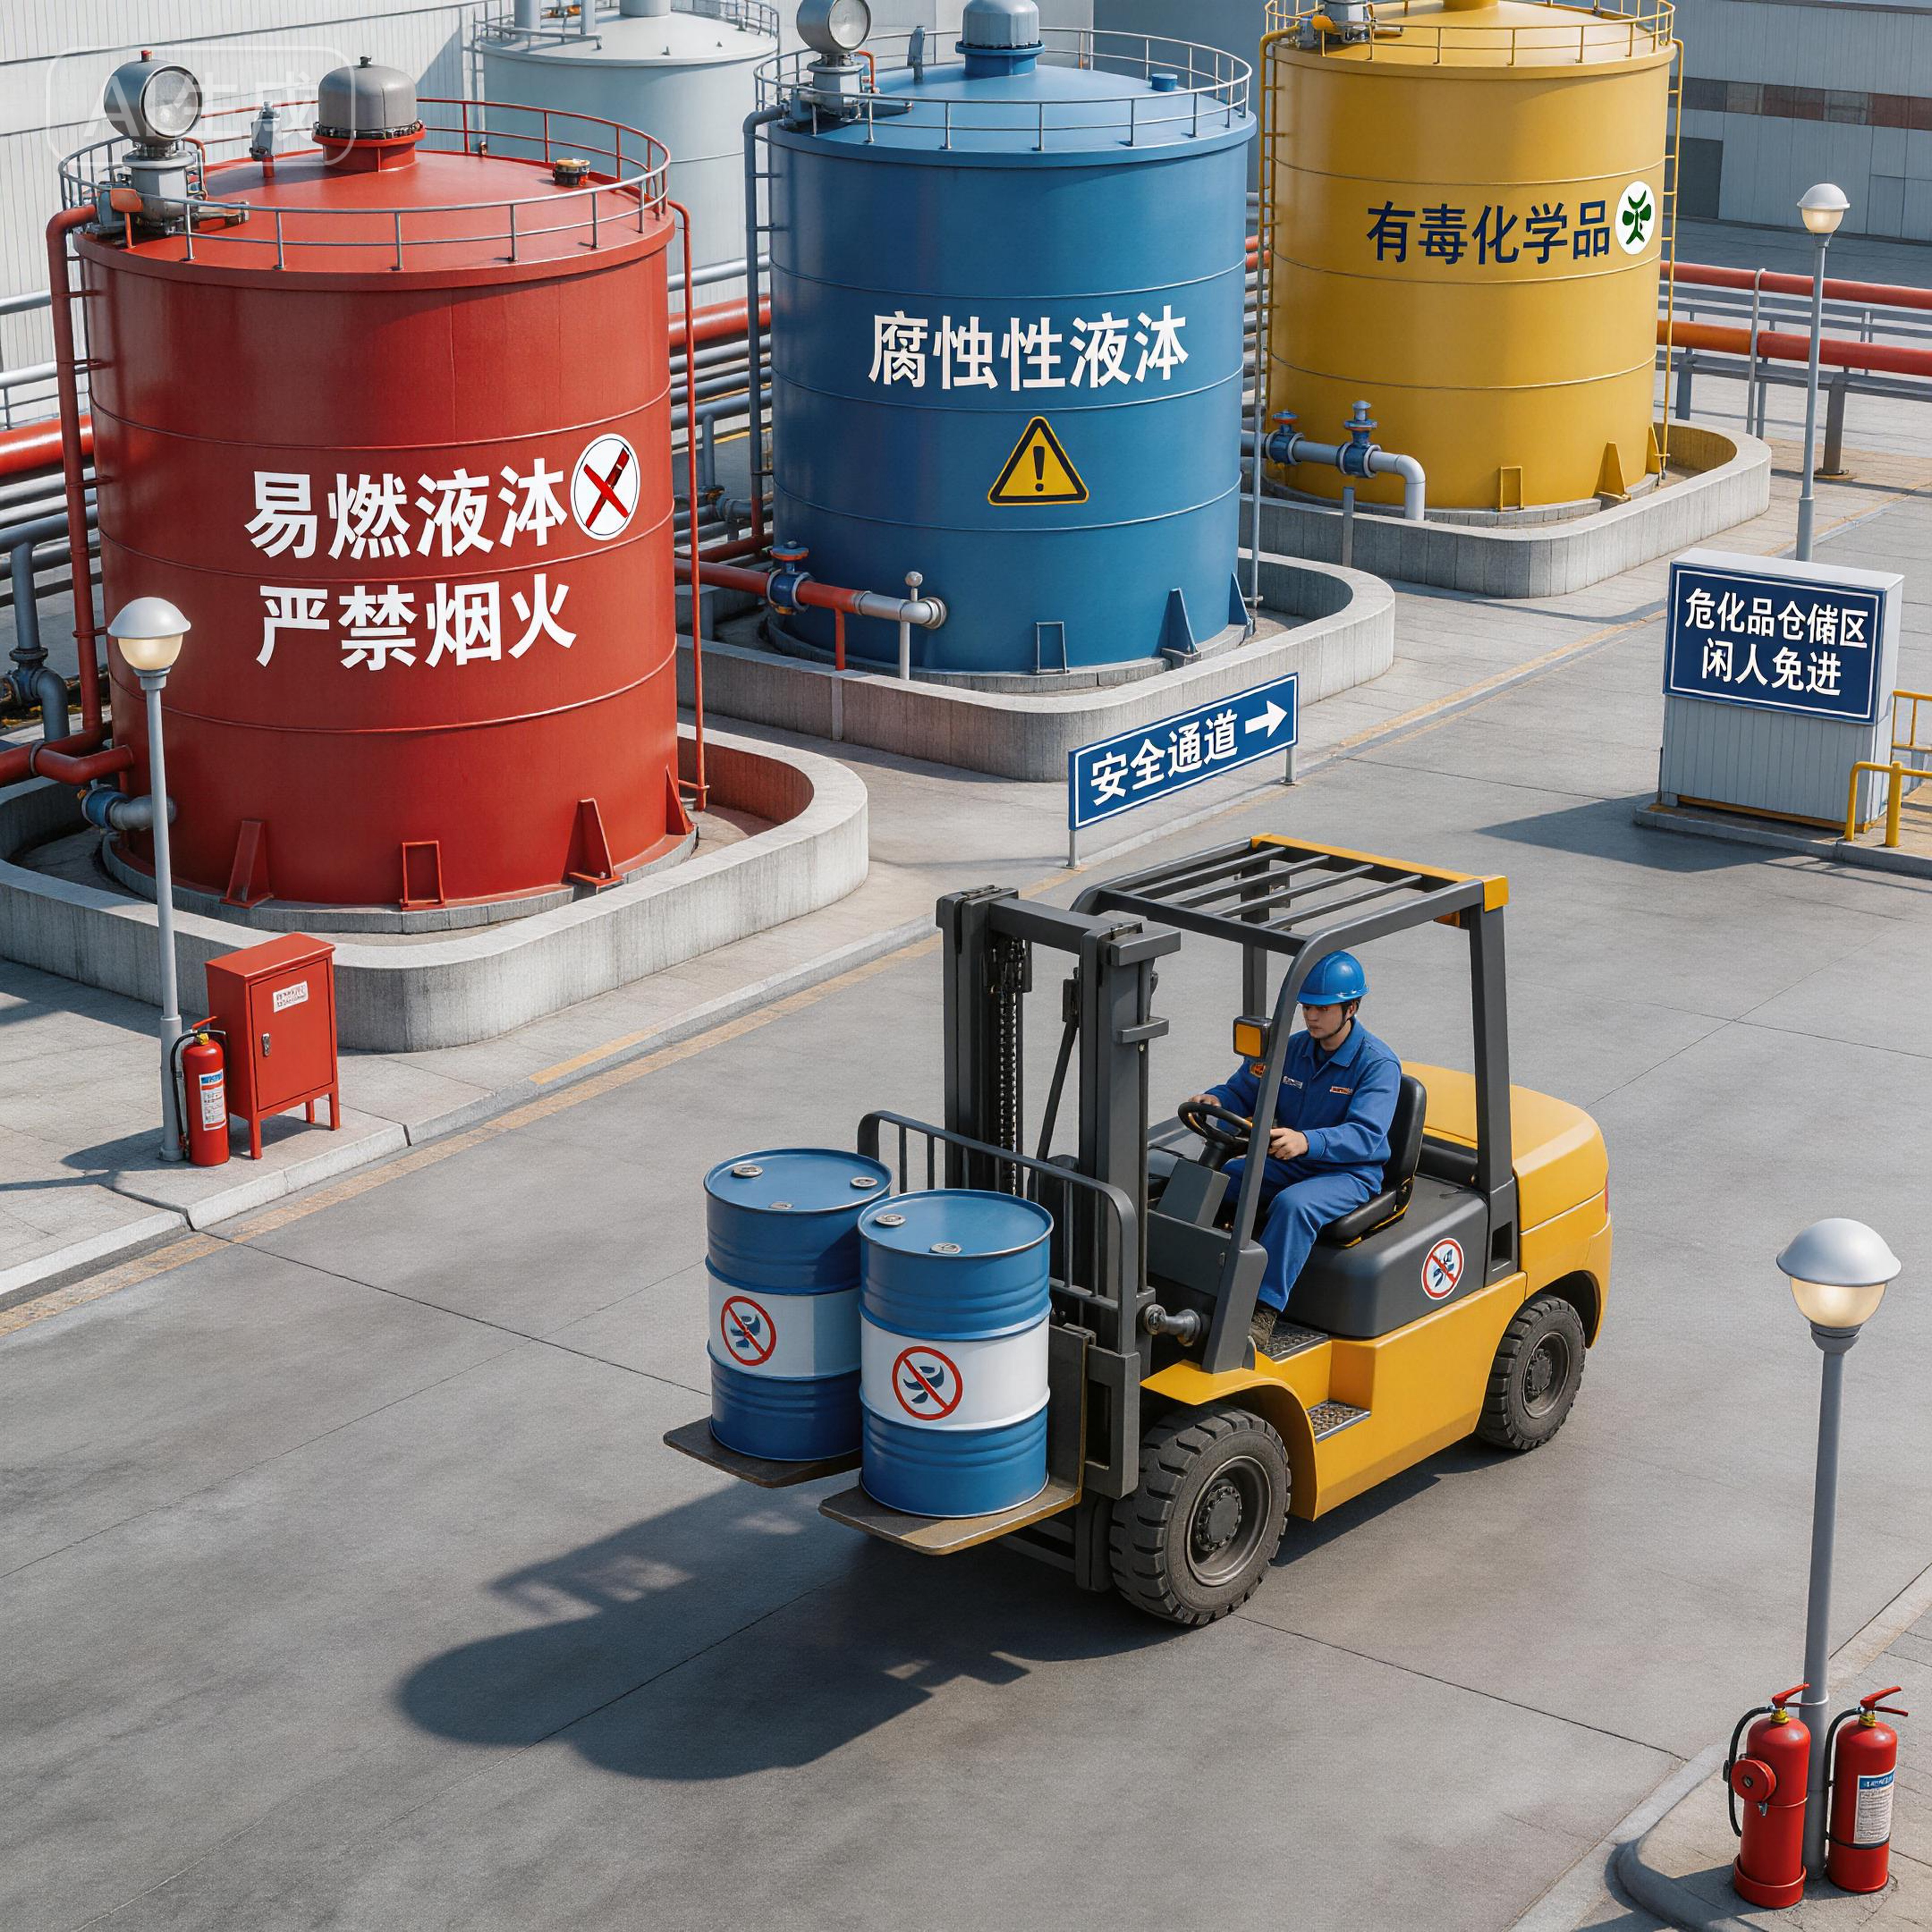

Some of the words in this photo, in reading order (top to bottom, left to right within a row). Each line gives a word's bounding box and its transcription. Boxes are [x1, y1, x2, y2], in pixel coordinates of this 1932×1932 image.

[1366, 200, 1610, 265] 有毒化学品
[256, 573, 577, 671] 严禁烟火
[1684, 587, 1868, 649] 危化品仓储区
[1701, 638, 1841, 696] 闲人免进
[1091, 709, 1238, 806] 安全通道
